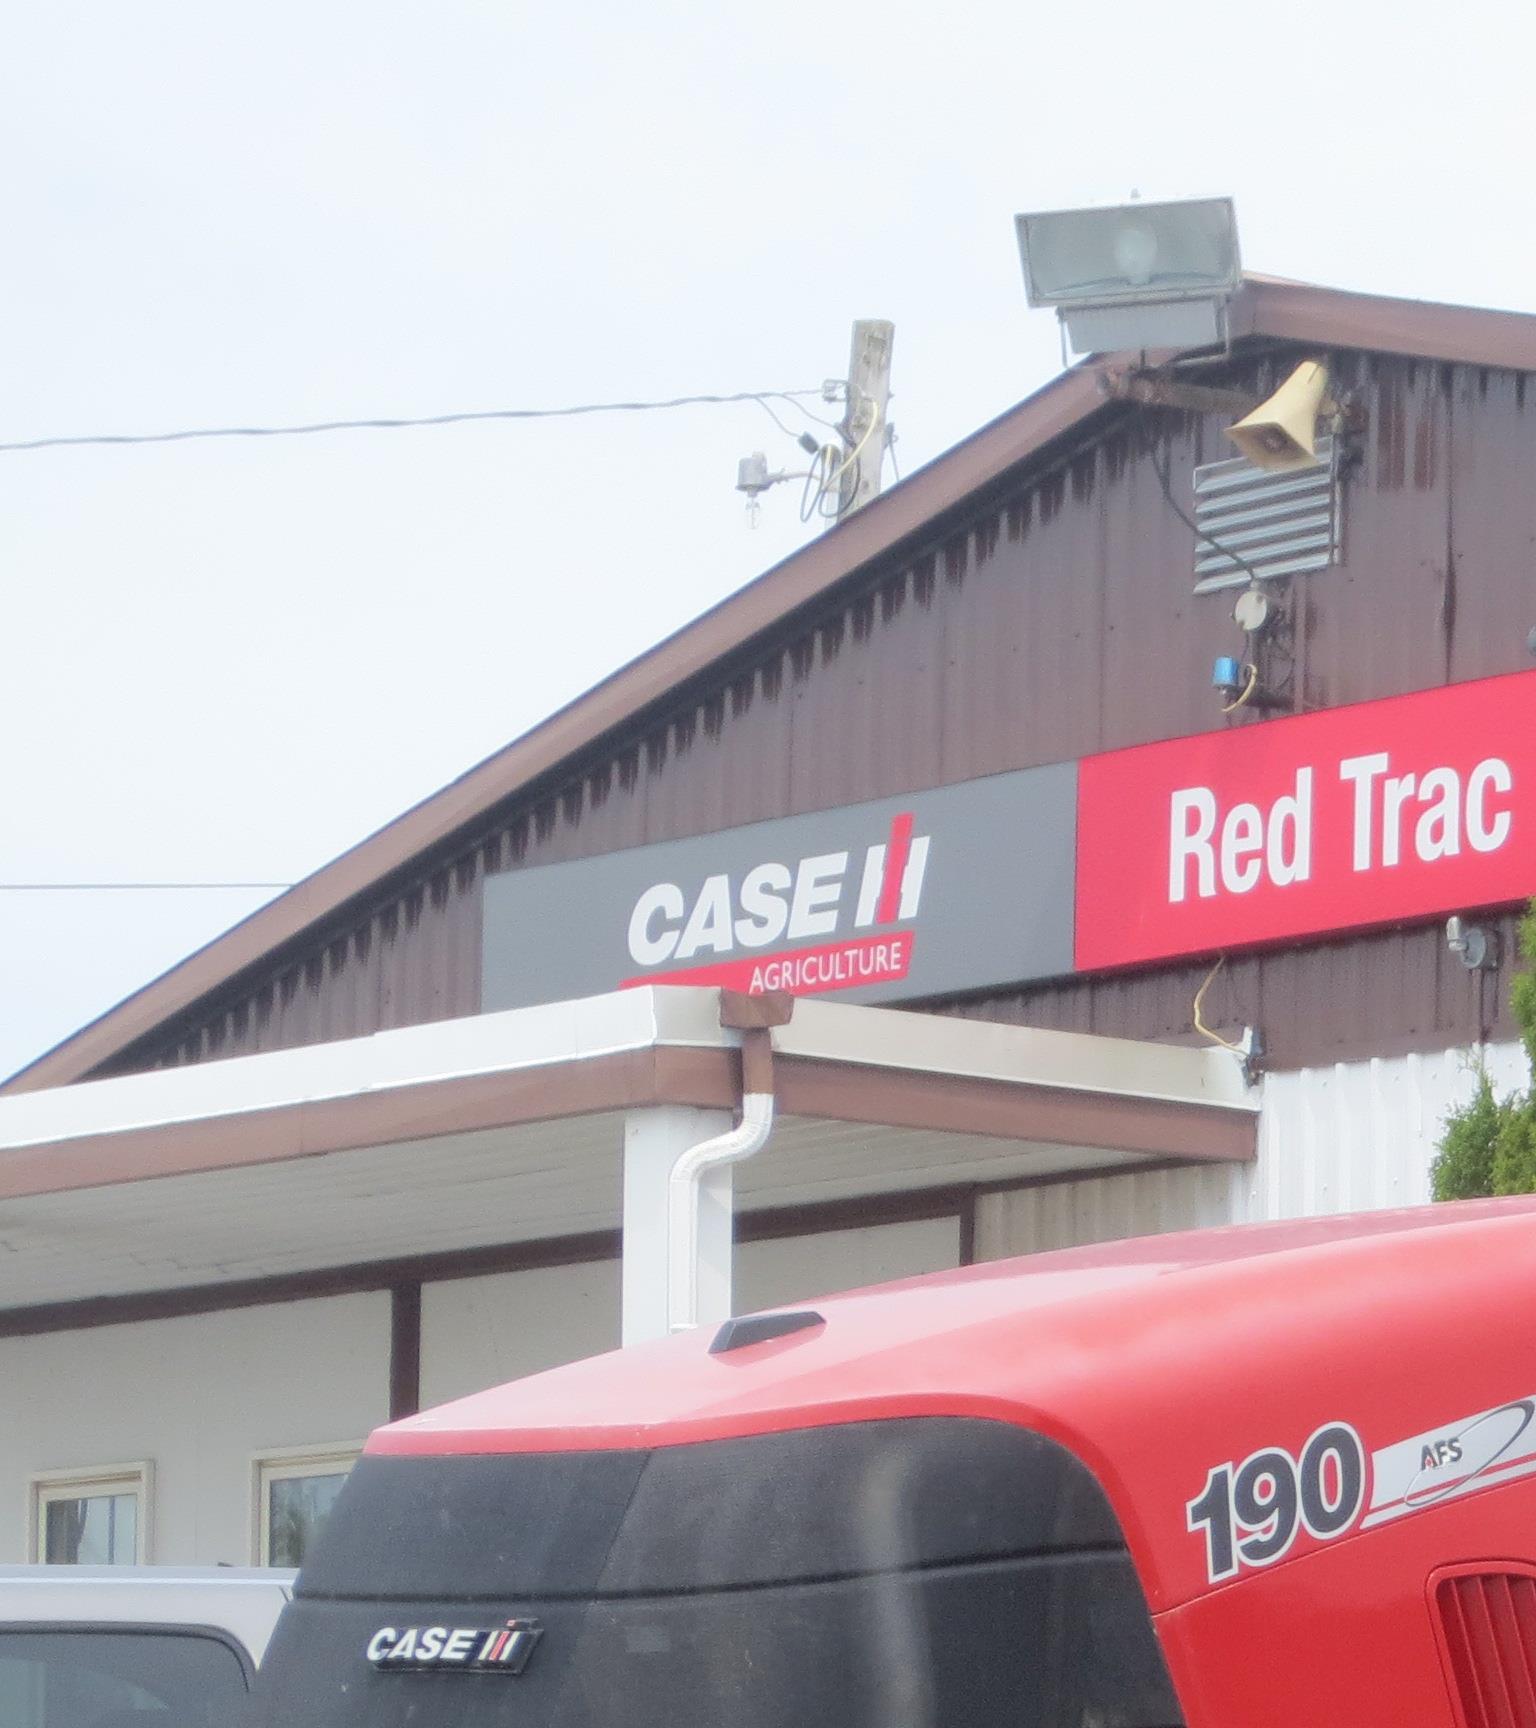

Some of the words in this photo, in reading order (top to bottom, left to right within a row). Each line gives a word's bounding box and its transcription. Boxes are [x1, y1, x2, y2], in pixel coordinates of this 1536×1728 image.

[1168, 768, 1312, 903] Red
[1340, 753, 1513, 872] Trac
[748, 942, 902, 995] AGRICULTURE
[1186, 1421, 1366, 1584] 190
[1420, 1437, 1463, 1471] AFS
